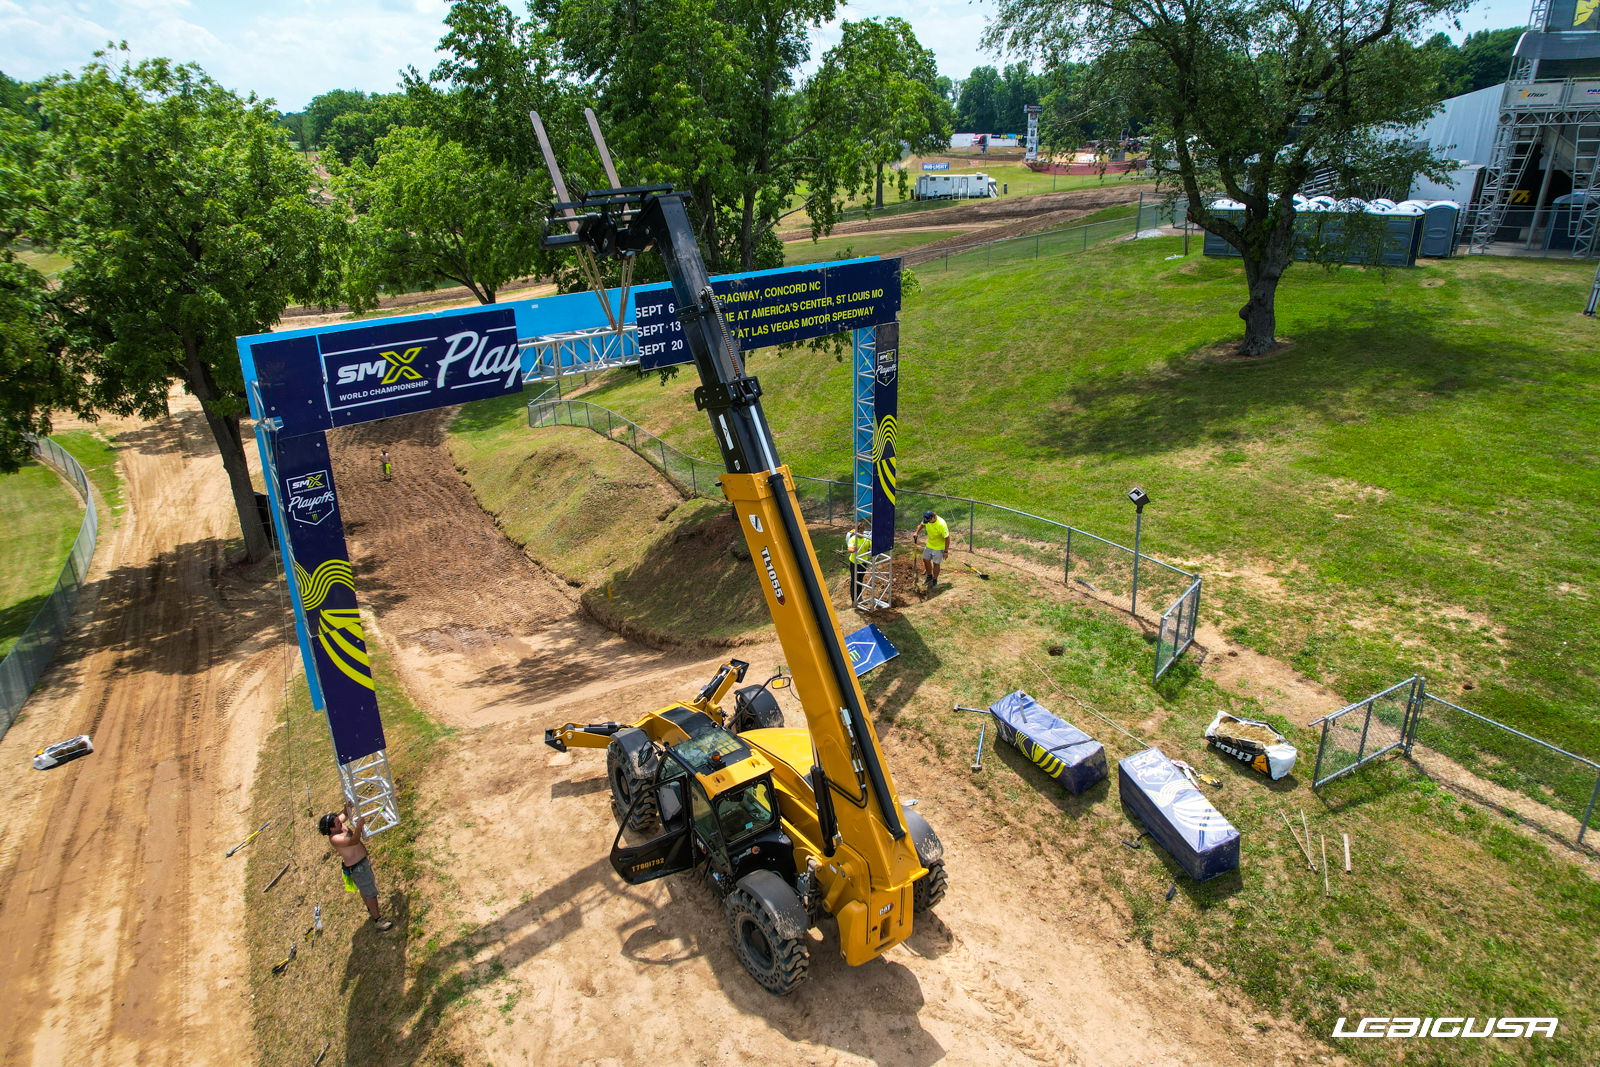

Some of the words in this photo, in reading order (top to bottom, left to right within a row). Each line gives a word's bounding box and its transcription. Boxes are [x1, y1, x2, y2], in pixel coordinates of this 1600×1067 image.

[764, 283, 807, 298] CONCORD
[809, 280, 821, 291] NC
[635, 304, 663, 318] SEPT
[668, 303, 675, 314] 6
[737, 309, 749, 321] AT
[751, 302, 799, 318] AMERICA'S
[800, 296, 835, 310] CENTER,
[836, 294, 846, 304] ST
[847, 290, 870, 303] LOUIS
[871, 288, 884, 299] MO
[637, 323, 665, 338] SEPT
[670, 320, 681, 332] 13
[737, 328, 749, 339] AT
[751, 324, 769, 337] LAS
[770, 319, 800, 333] VEGAS
[801, 313, 831, 328] MOTOR
[832, 306, 874, 322] SPEEDWAY
[639, 342, 666, 357] SEPT
[671, 339, 683, 351] 20
[336, 346, 424, 385] SMX
[339, 391, 369, 402] WORLD
[369, 380, 429, 396] CHAMPIONSHIP
[292, 474, 323, 489] SMX
[288, 490, 335, 513] Playoffs
[761, 545, 784, 599] TL1055
